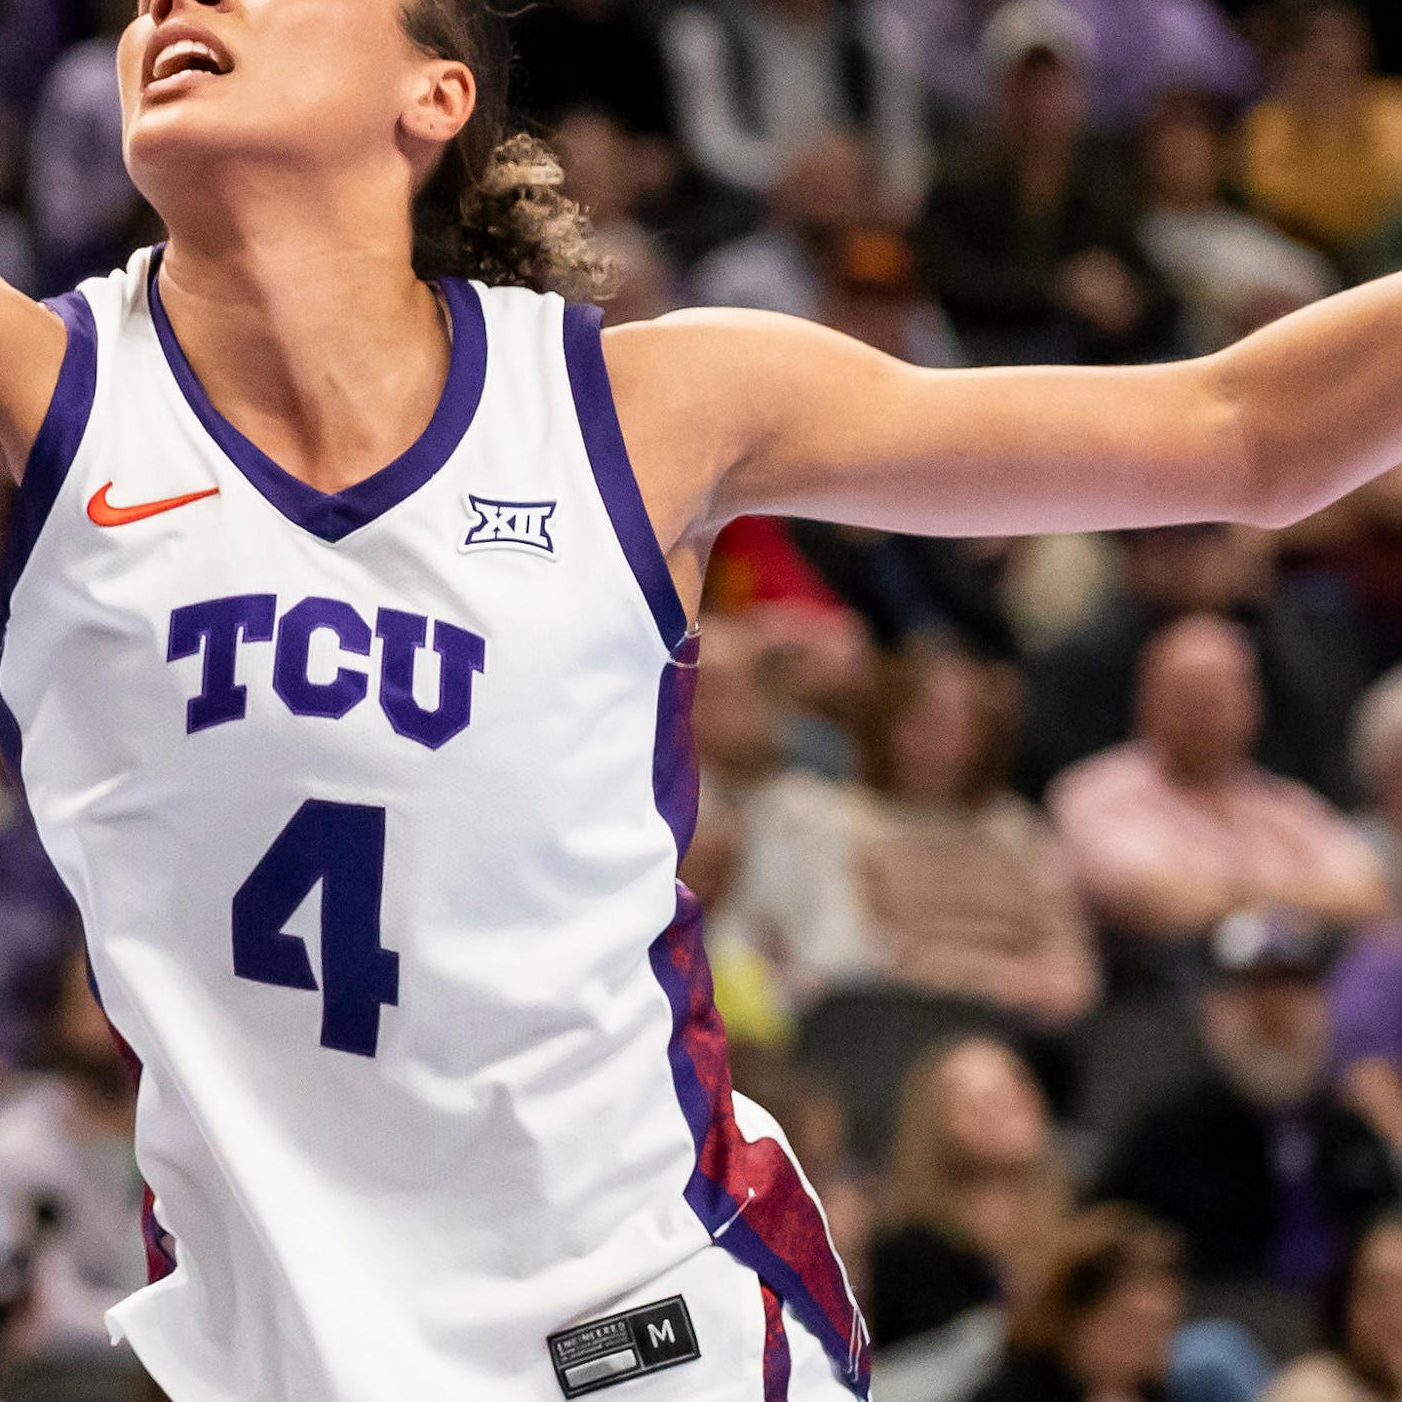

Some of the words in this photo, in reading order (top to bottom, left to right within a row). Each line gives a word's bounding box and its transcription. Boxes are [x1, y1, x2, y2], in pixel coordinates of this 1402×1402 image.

[465, 494, 557, 554] XII
[166, 593, 486, 751] TCU
[232, 798, 400, 1058] 4
[647, 1318, 676, 1348] M
